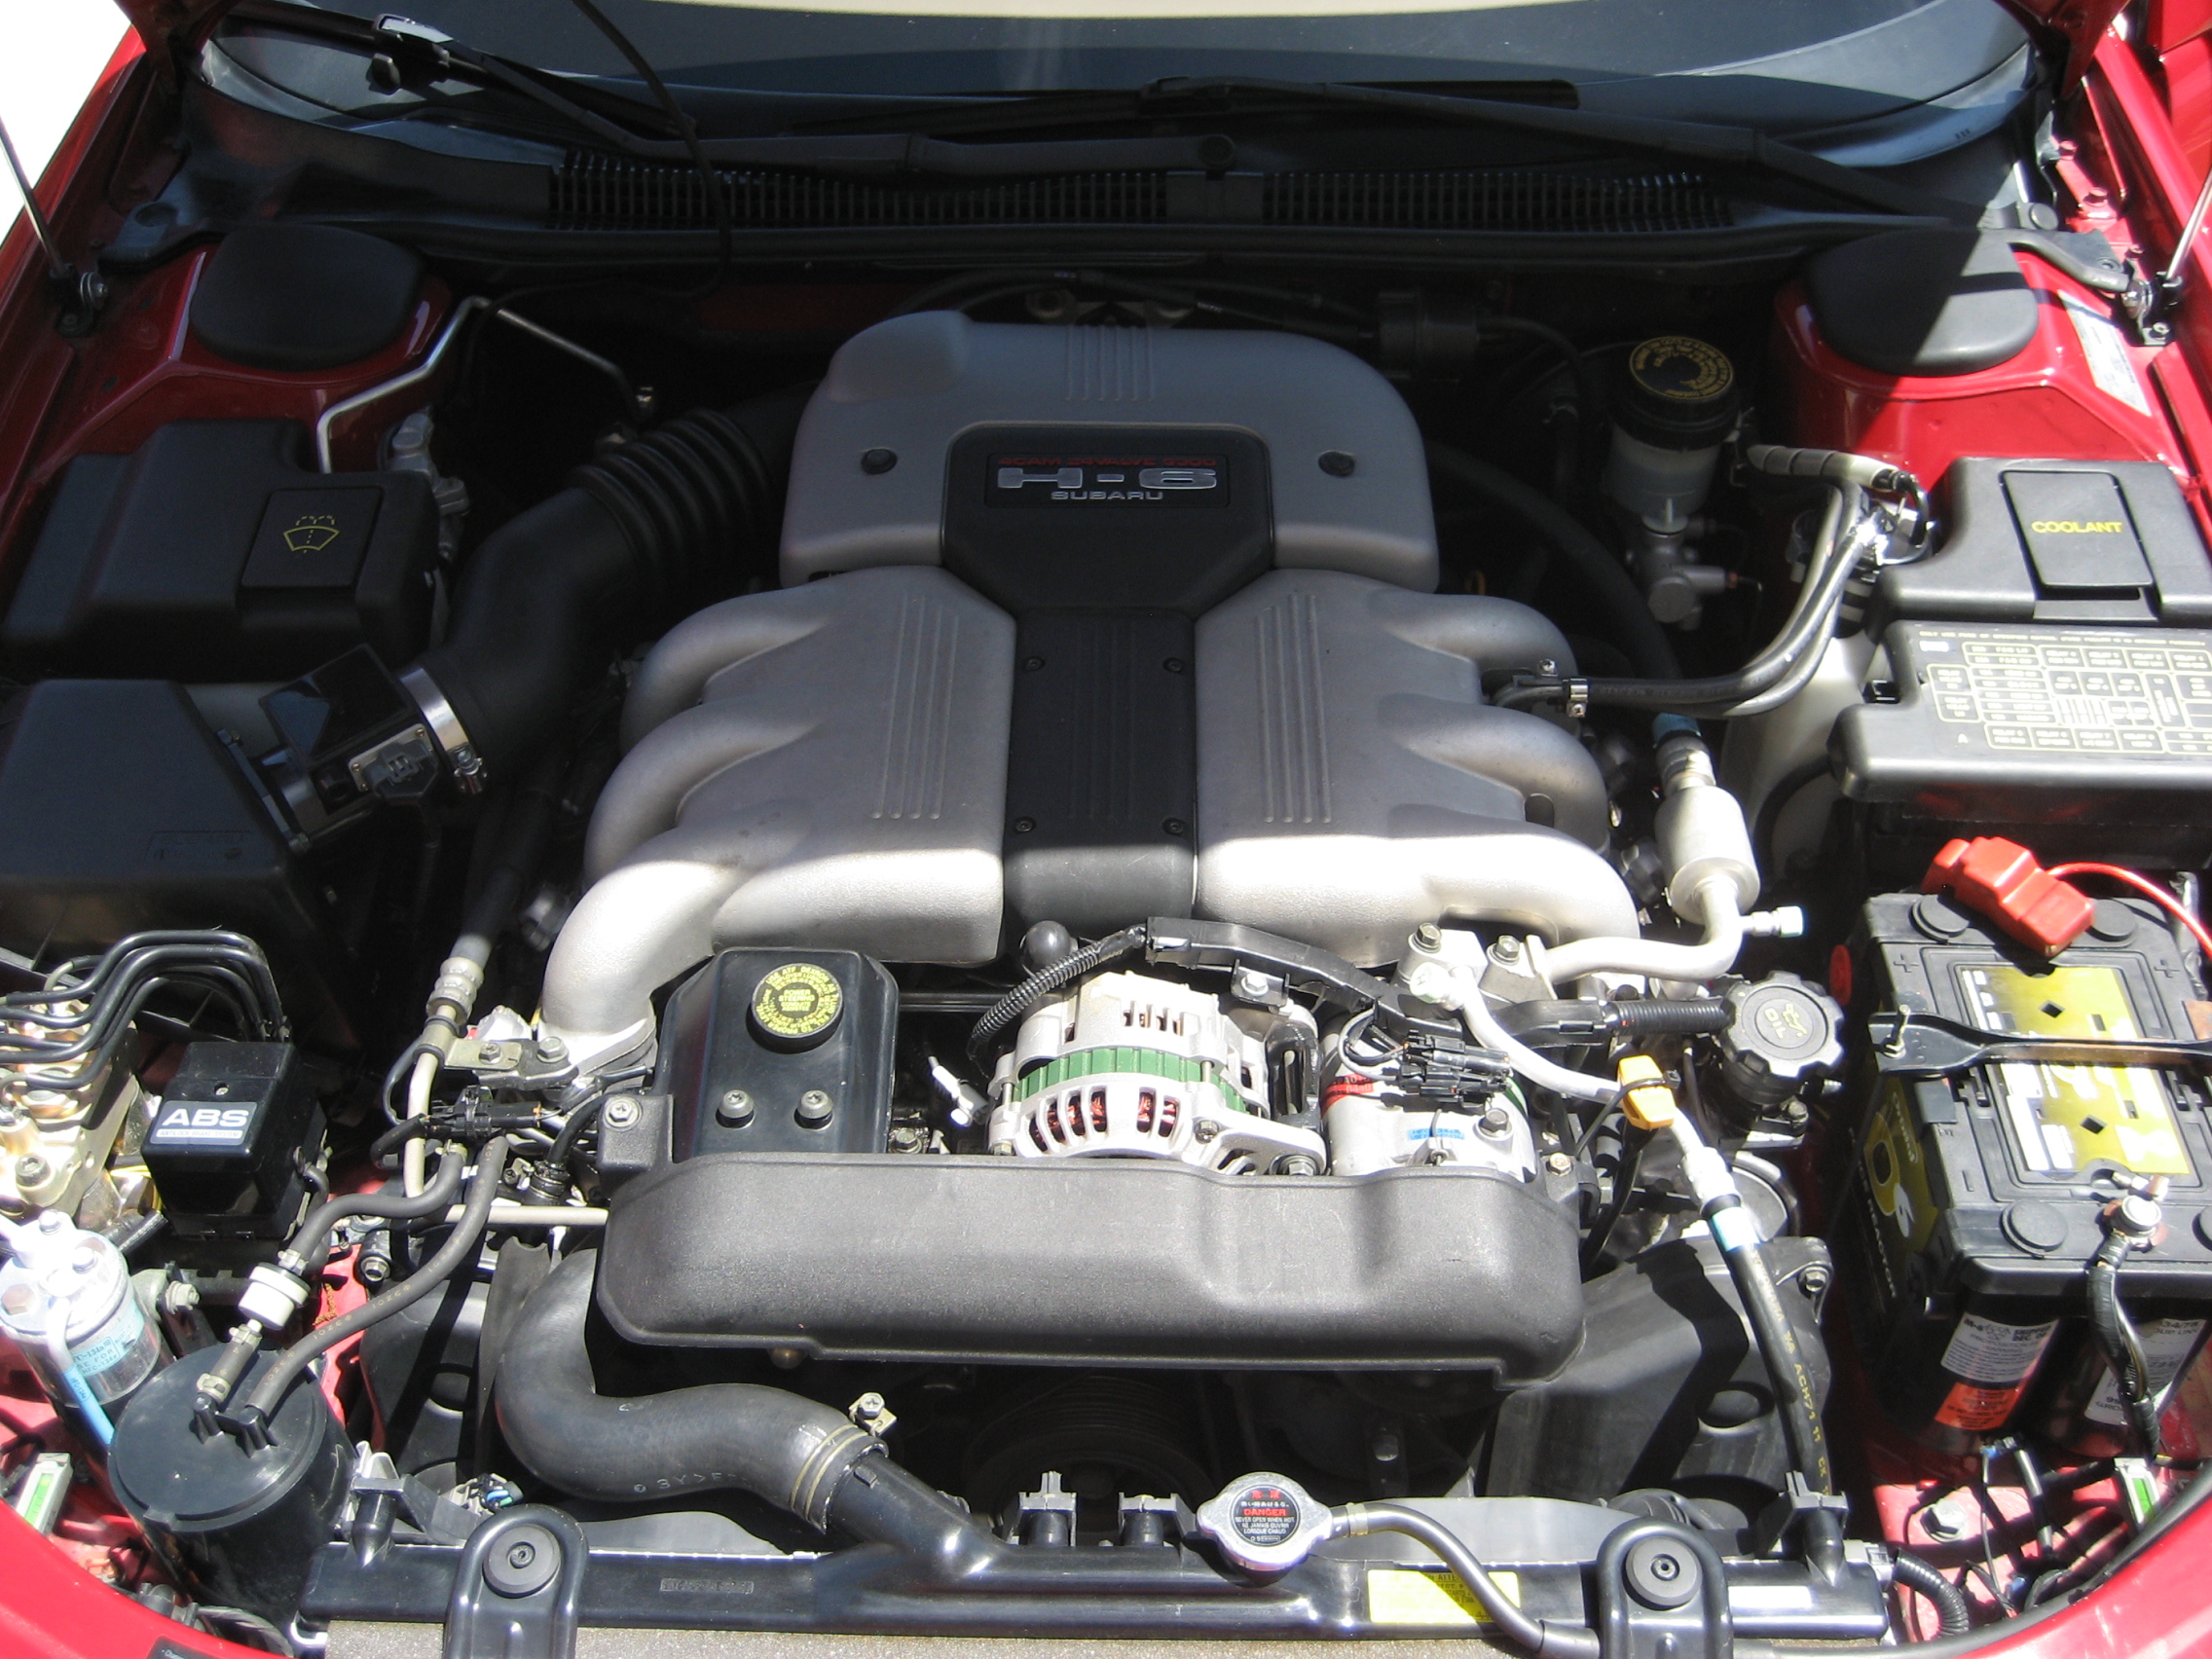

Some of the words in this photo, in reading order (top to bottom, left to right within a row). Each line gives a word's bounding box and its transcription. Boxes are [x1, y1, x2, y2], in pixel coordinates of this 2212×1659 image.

[997, 467, 1217, 489] H-6
[1051, 491, 1163, 500] SUBARU
[2031, 521, 2122, 533] COOLANT
[1764, 1008, 1787, 1039] OIL
[162, 1108, 249, 1126] ABS
[94, 1348, 114, 1362] FOR
